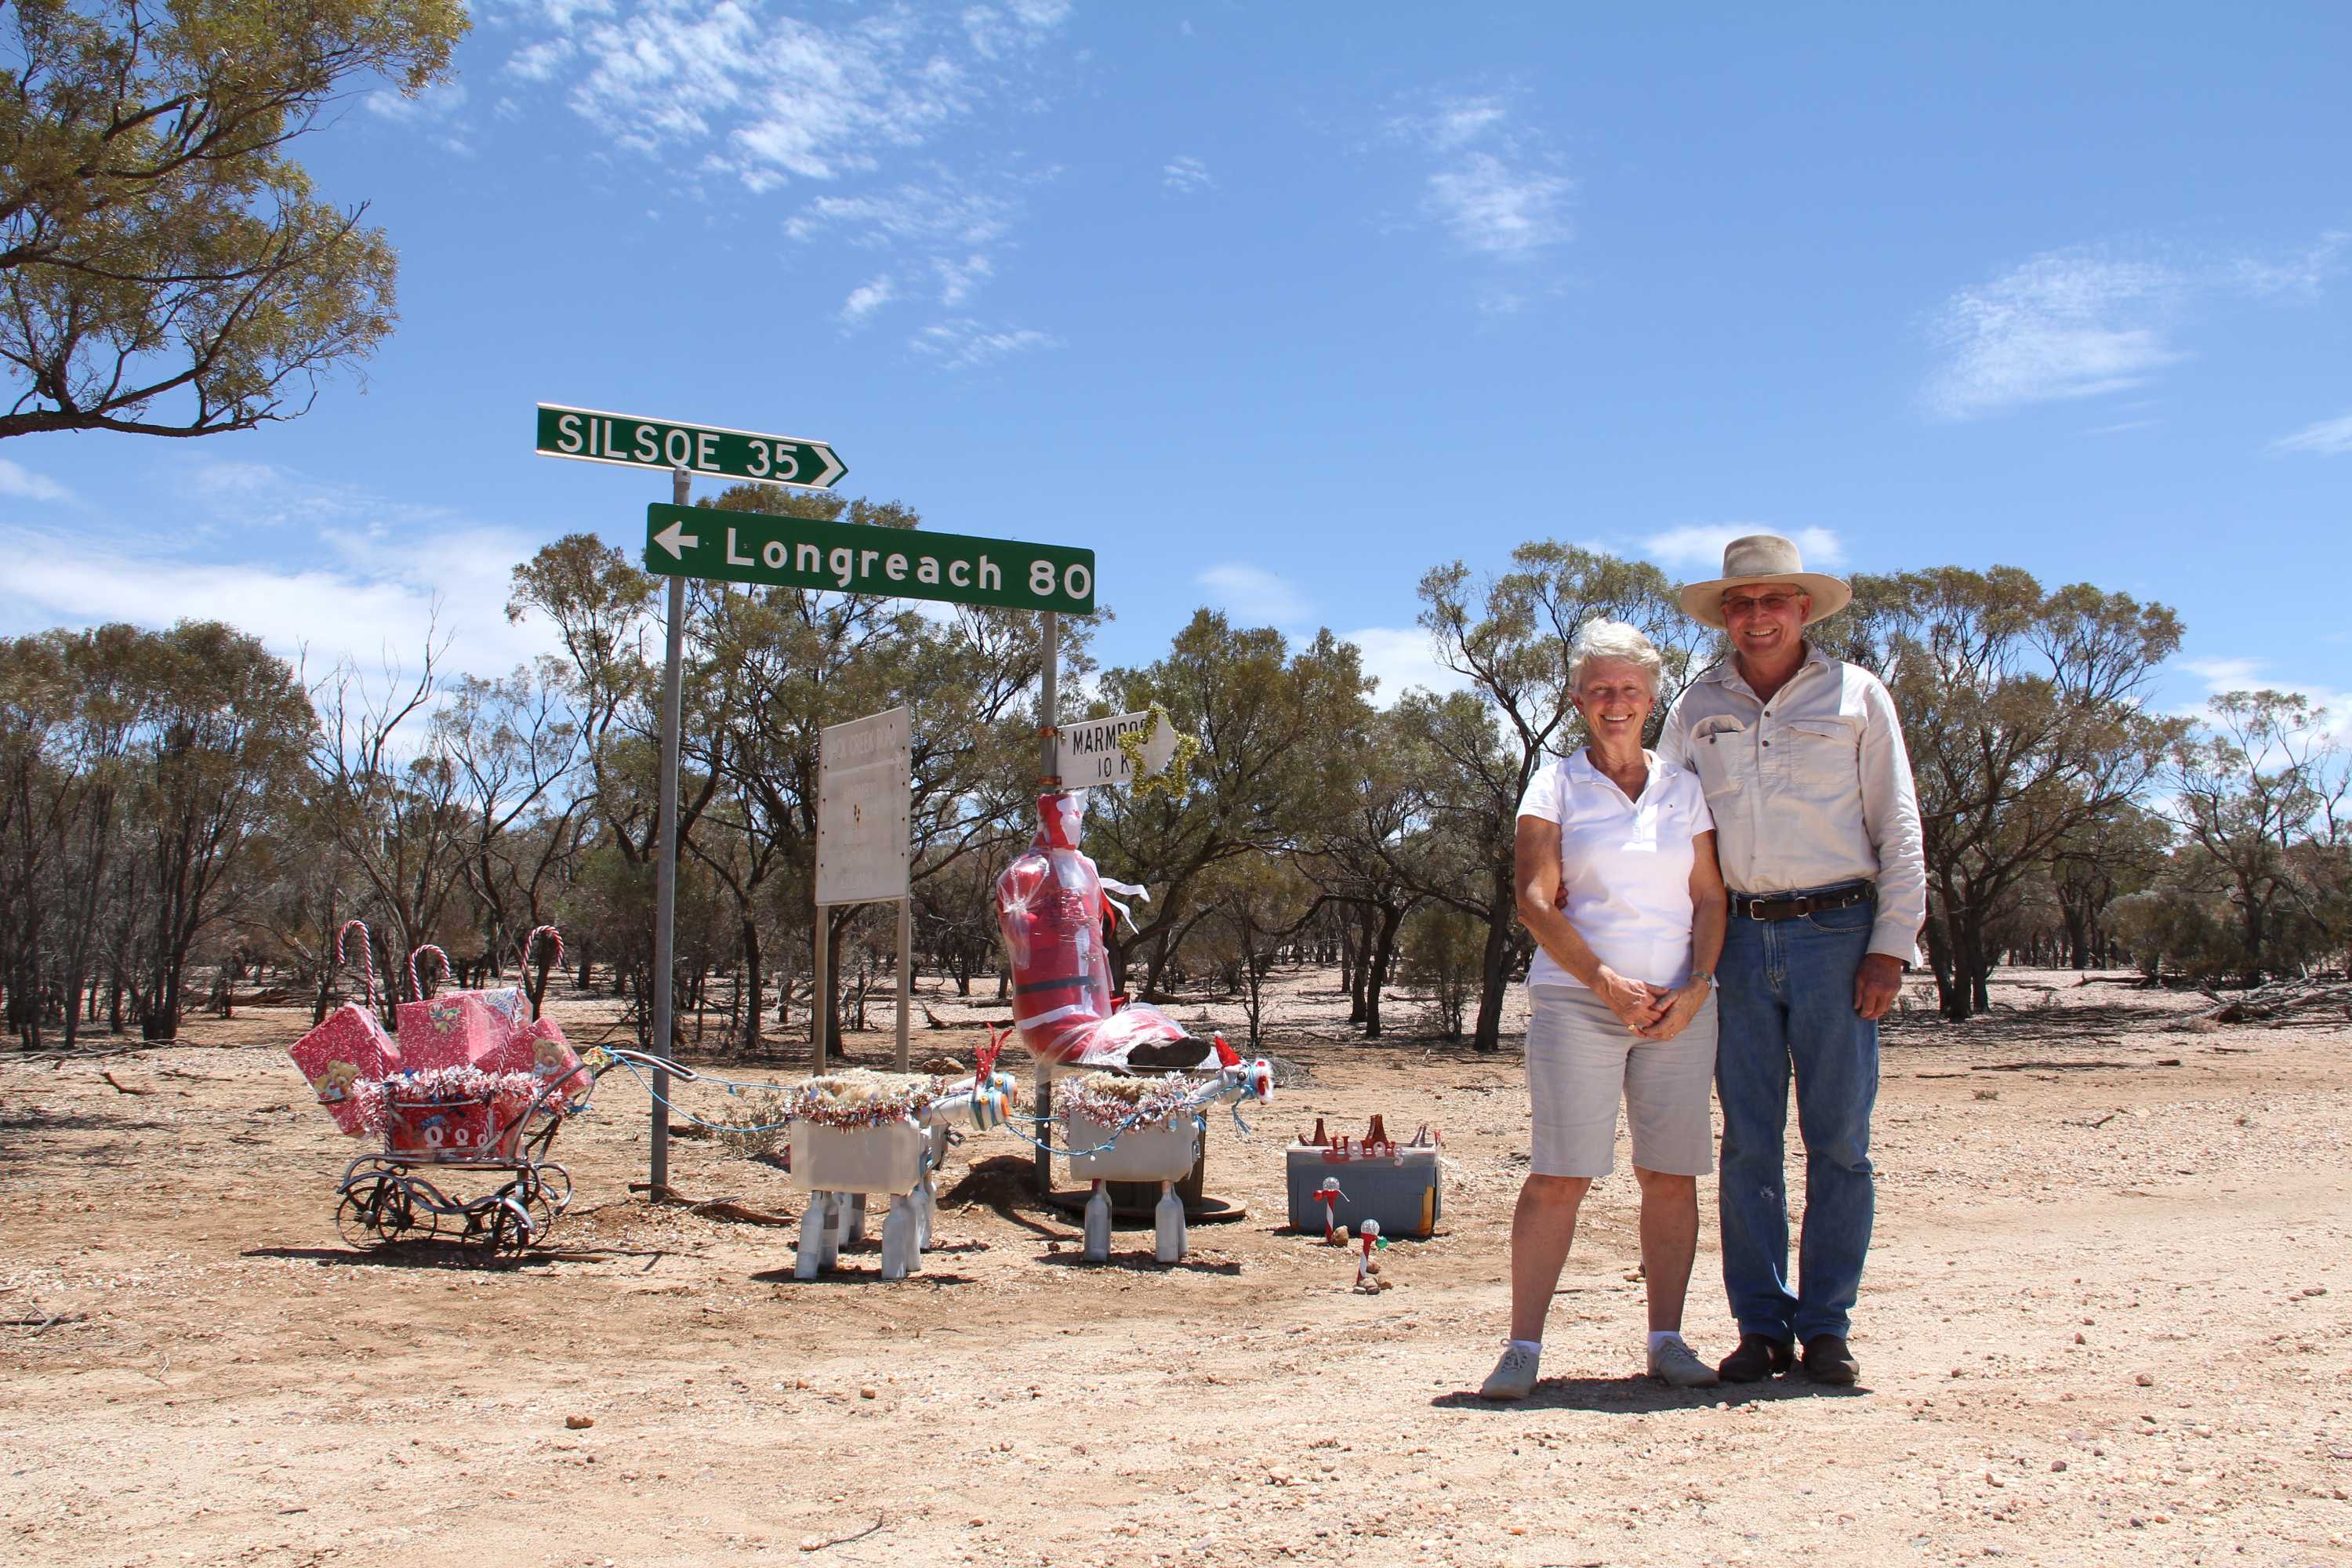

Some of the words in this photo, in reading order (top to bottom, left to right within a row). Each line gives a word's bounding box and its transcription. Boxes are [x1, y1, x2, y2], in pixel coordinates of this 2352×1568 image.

[557, 414, 720, 471] SILSOE
[746, 439, 800, 481] 35
[727, 527, 1002, 588] Longreach
[1029, 560, 1092, 599] 80
[1098, 757, 1112, 778] 10
